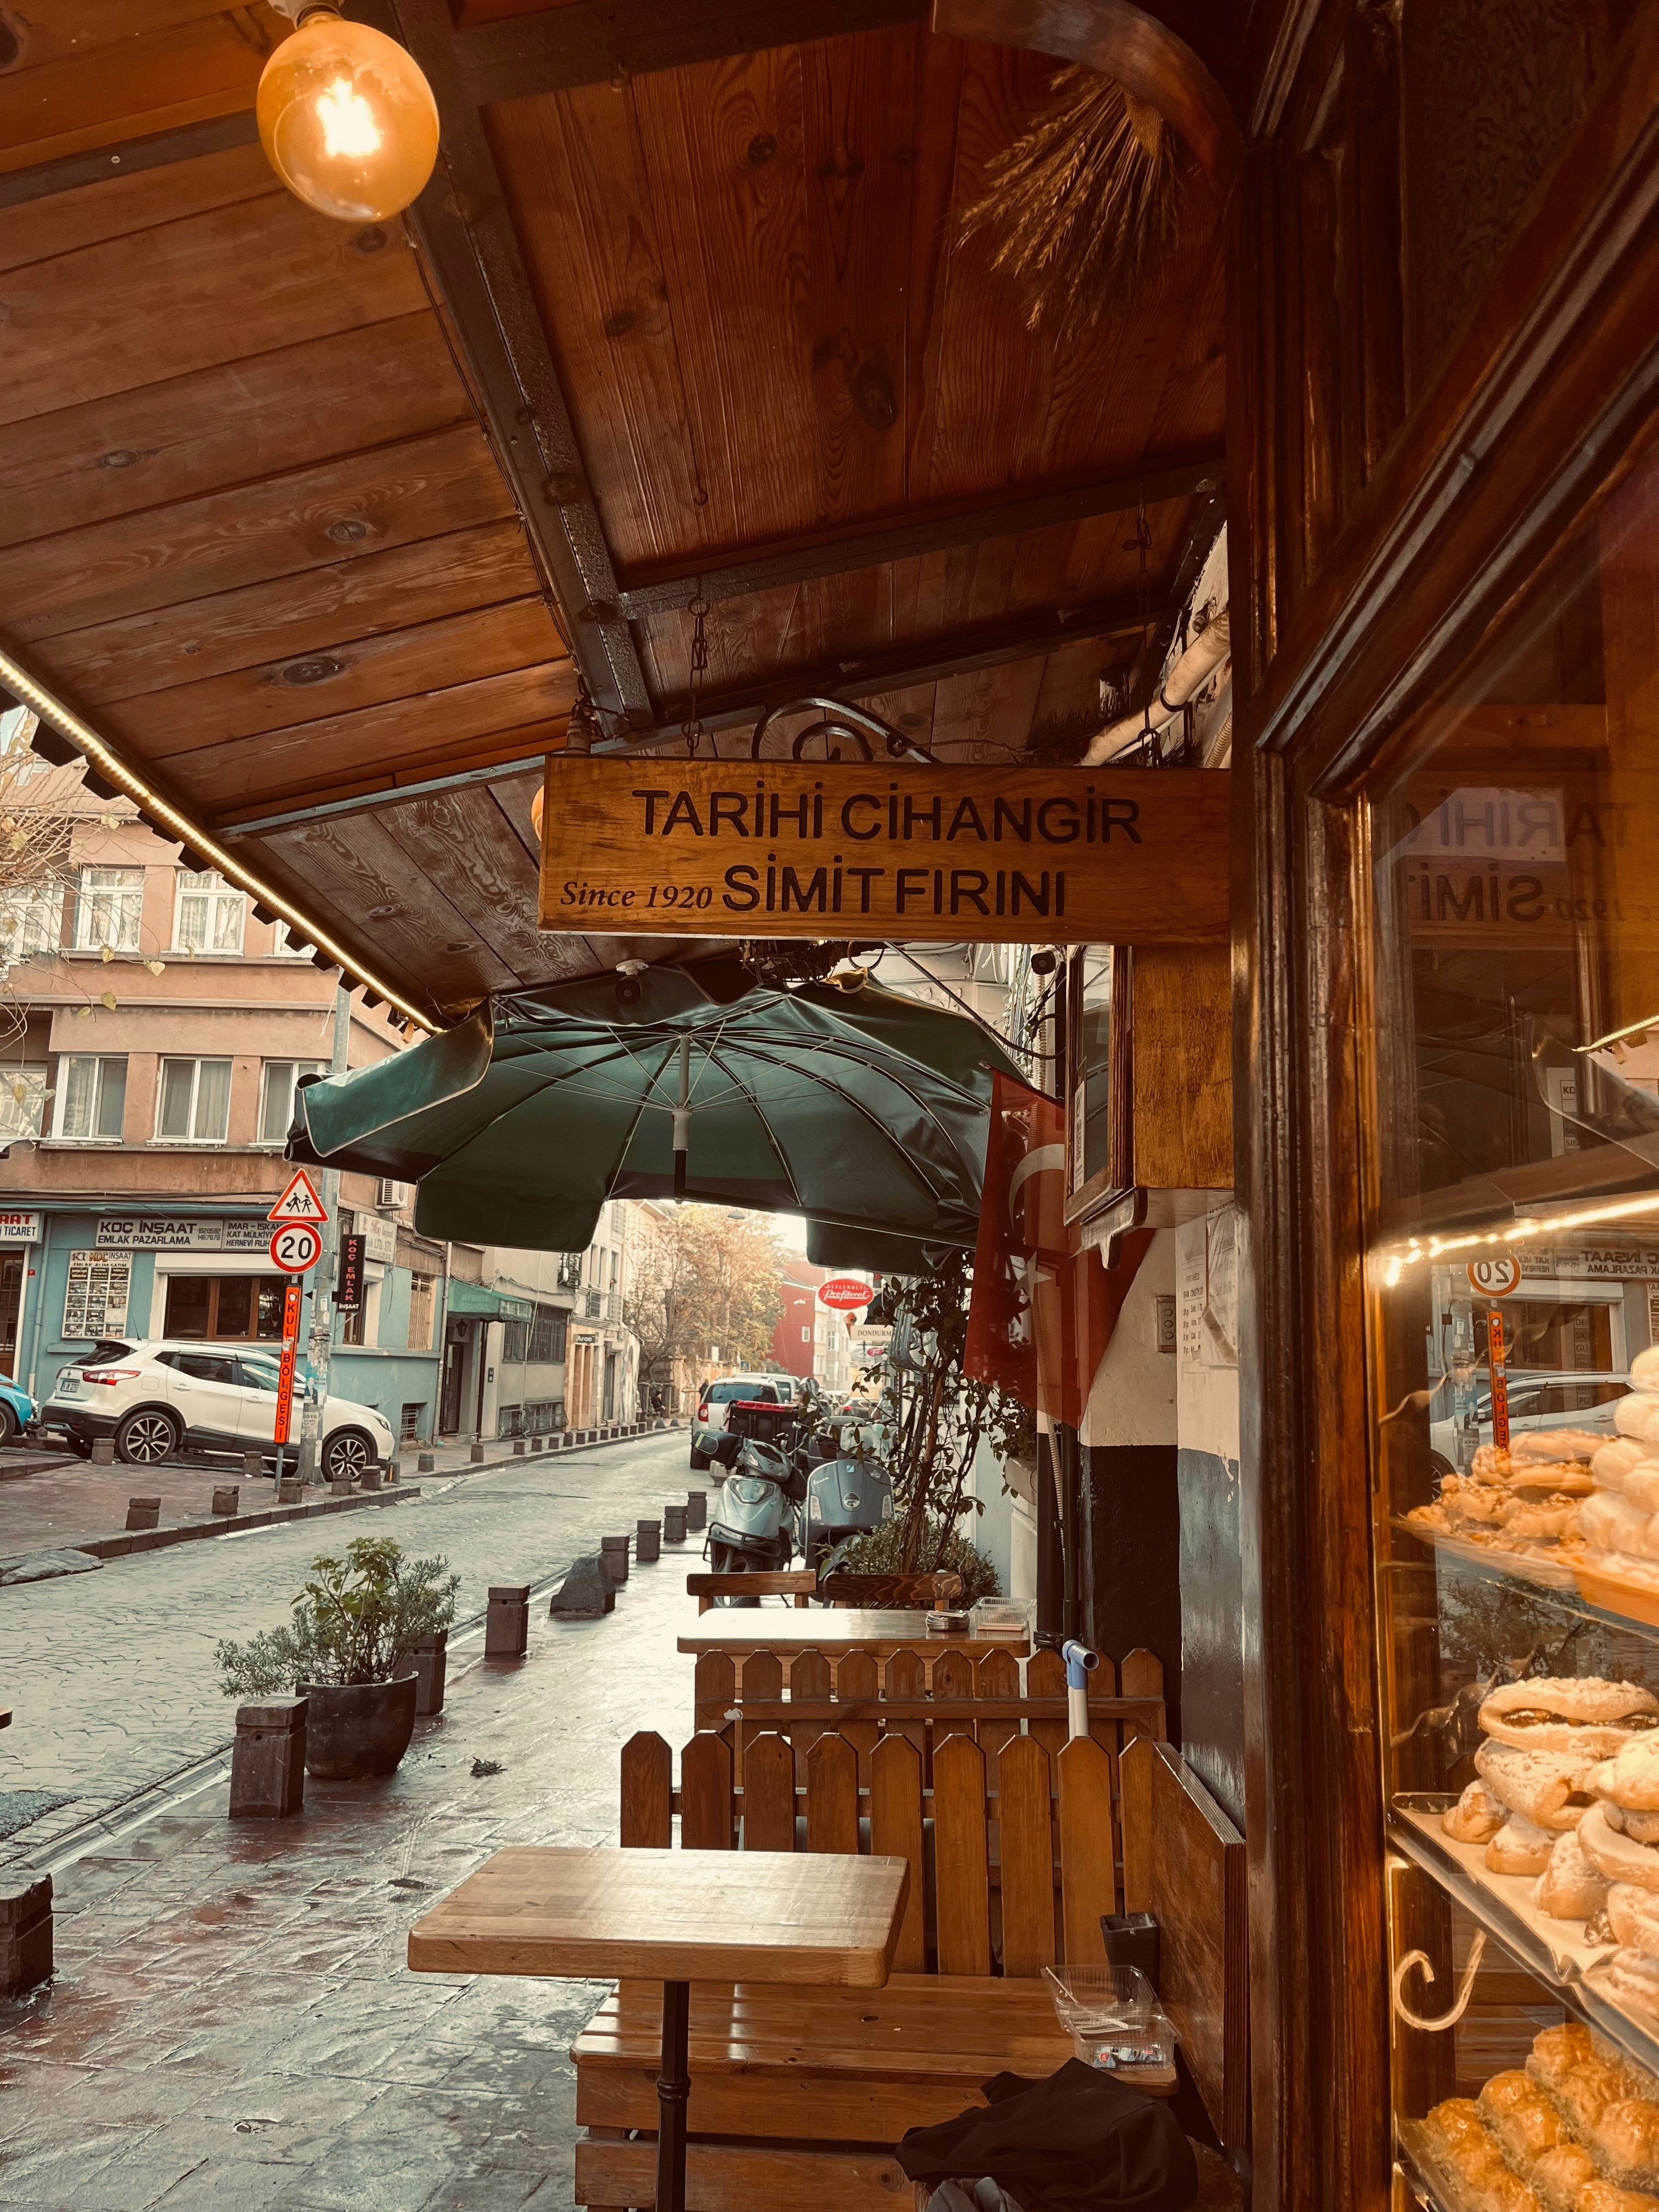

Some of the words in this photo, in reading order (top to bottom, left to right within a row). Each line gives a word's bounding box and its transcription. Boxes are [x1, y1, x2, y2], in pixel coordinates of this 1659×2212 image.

[631, 781, 824, 839] TARİHİ
[840, 781, 1142, 845] CİHANGİR
[560, 879, 639, 909] Since
[646, 883, 712, 910] 1920
[721, 853, 884, 914] SİMİT
[896, 870, 1066, 917] FIRINI
[100, 1222, 133, 1234] KOÇ
[139, 1220, 197, 1234] İNŞAAT
[98, 1235, 129, 1244] EMLAK
[133, 1235, 190, 1244] PAZARLAMA
[281, 1236, 312, 1259] 20
[347, 1239, 358, 1261] KOÇ
[345, 1266, 356, 1301] EMLAK
